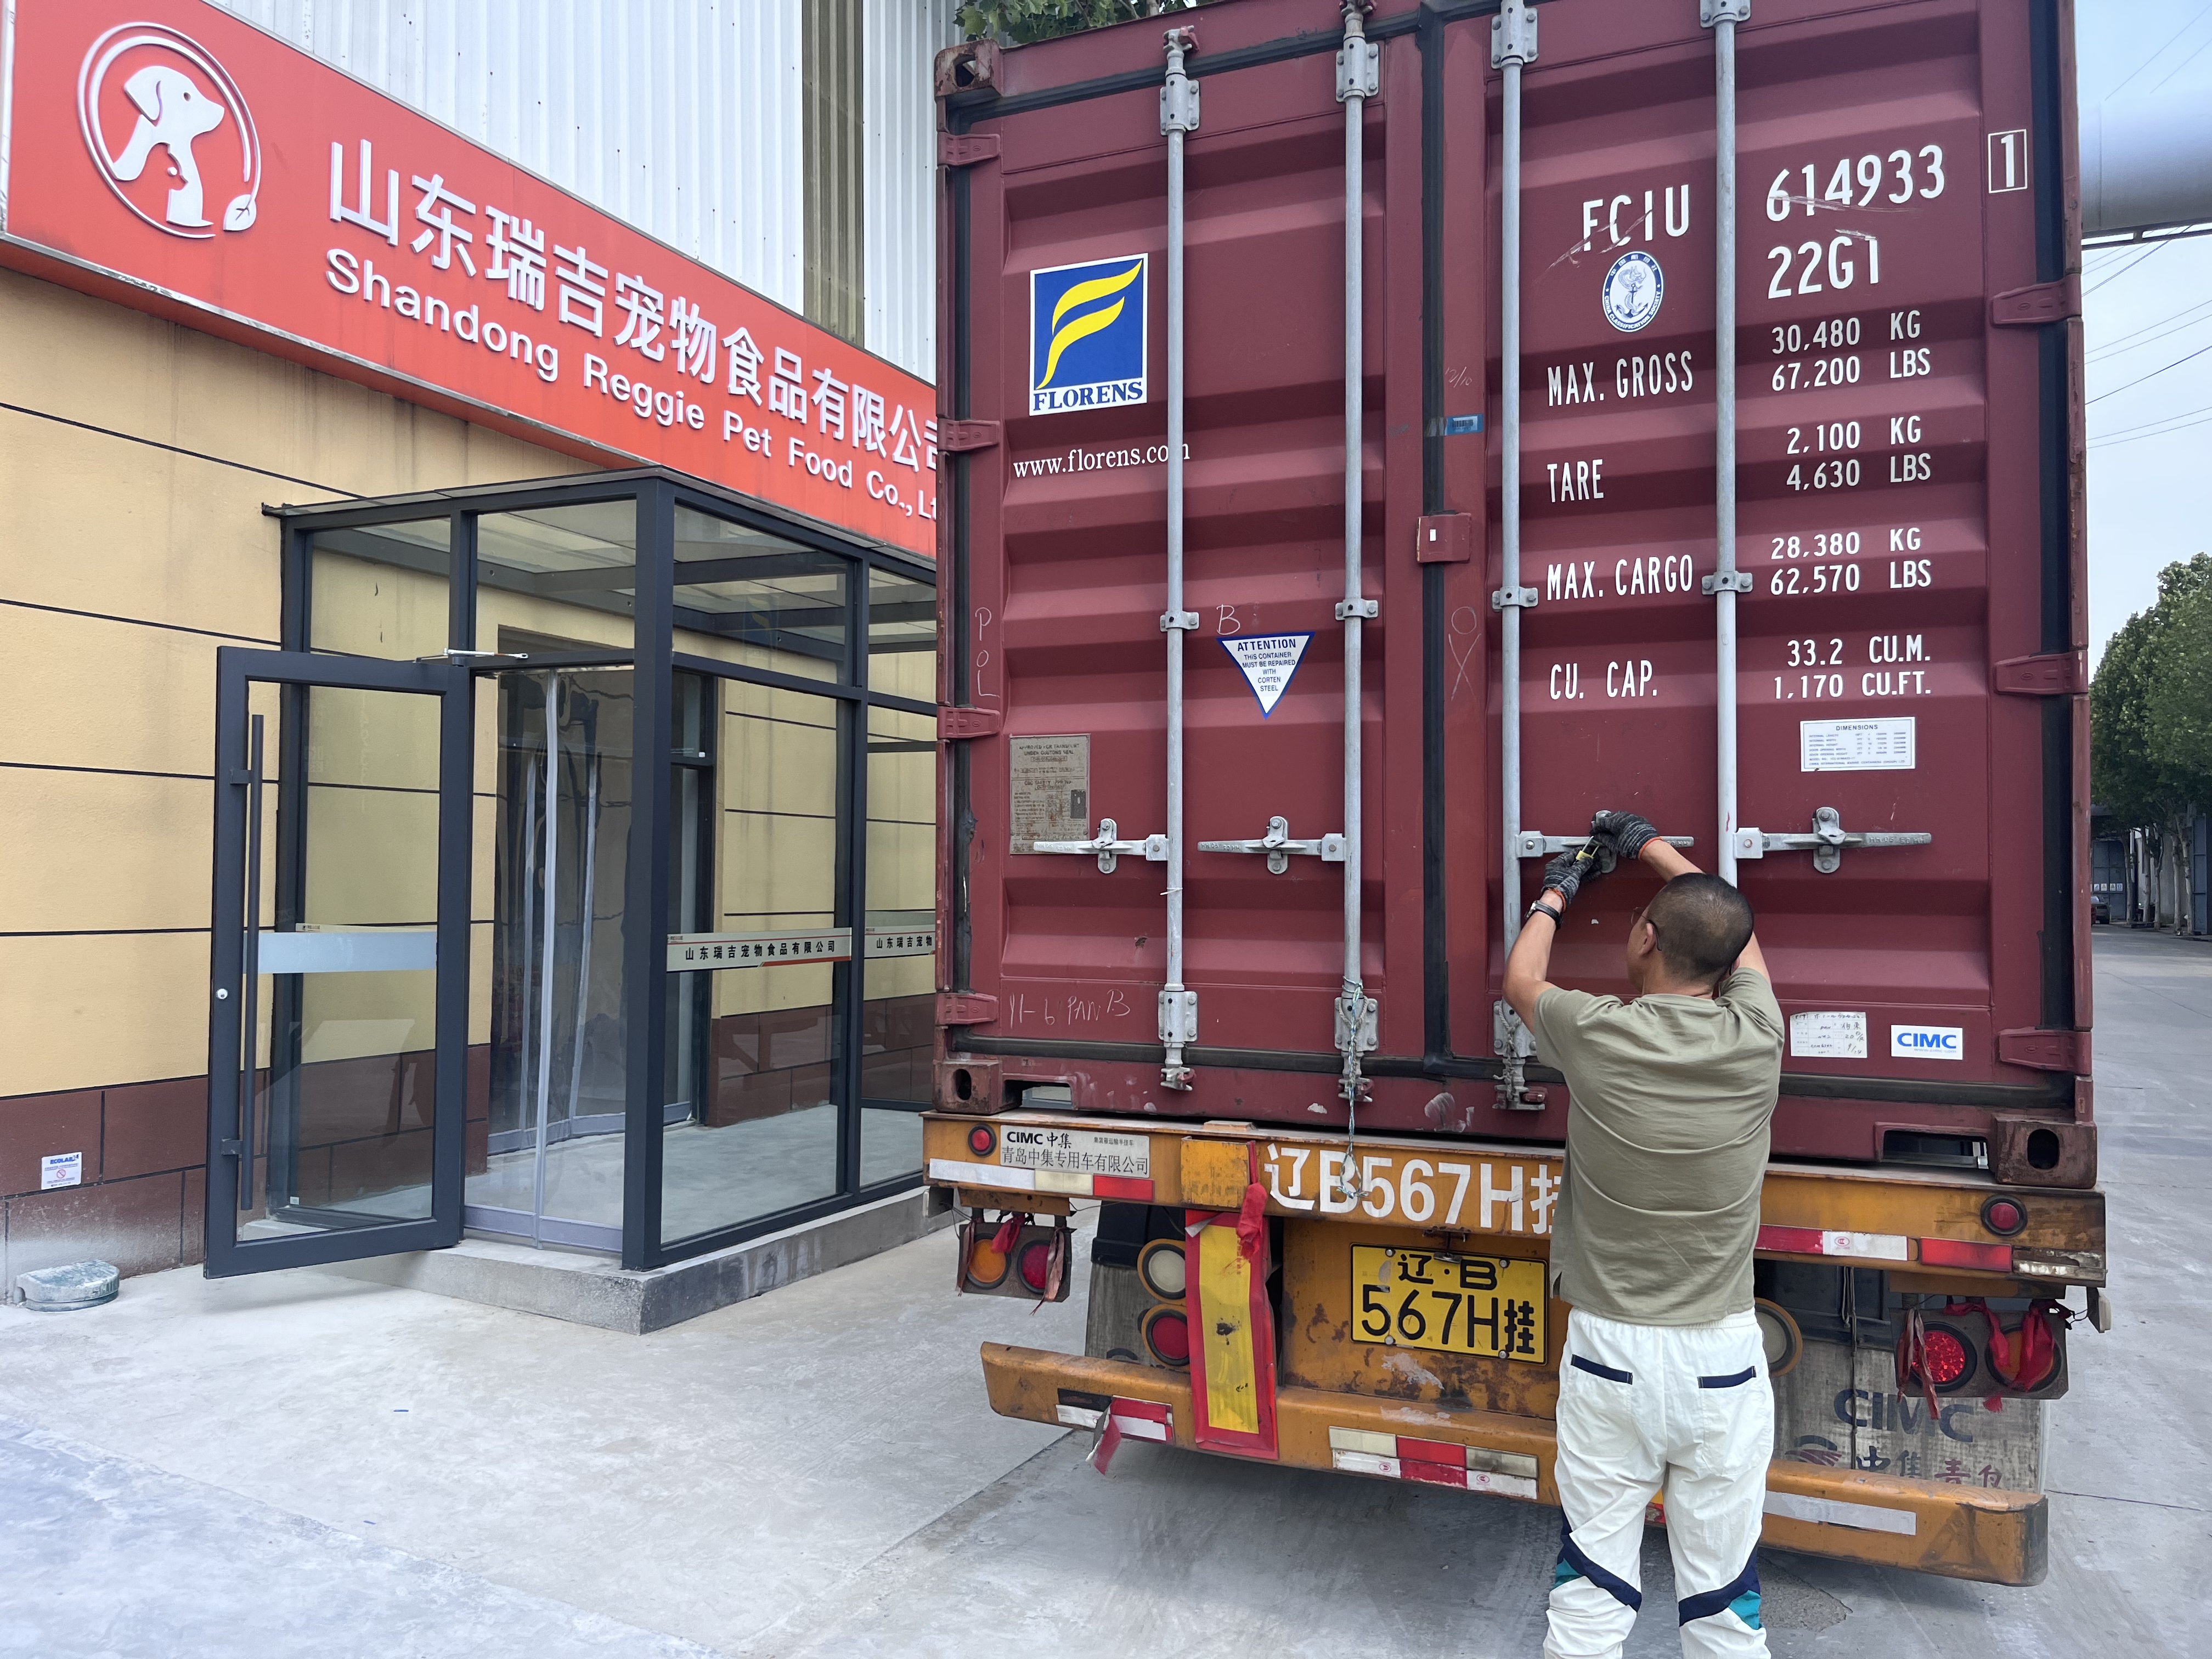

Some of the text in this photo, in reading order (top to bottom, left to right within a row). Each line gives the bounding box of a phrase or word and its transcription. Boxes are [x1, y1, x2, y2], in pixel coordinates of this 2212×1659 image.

[1766, 134, 2015, 222] 614933 1
[1583, 184, 1689, 251] FCIU
[1767, 235, 1879, 299] 22G1
[1609, 313, 1651, 329] CLASSIFICATION
[1649, 291, 1661, 315] SOCIETY
[1771, 310, 1920, 354] 30,480 KG
[326, 249, 558, 382] Shandong
[584, 352, 704, 430] Reggie
[724, 410, 771, 458] Pet
[788, 437, 852, 489] Food
[866, 471, 912, 517] Co.,
[1548, 351, 1692, 406] MAX. GROSS
[1771, 348, 1931, 391] 67,200 LBS
[1033, 381, 1143, 411] FLORENS
[1787, 415, 1921, 454] 2,100 KG
[1547, 459, 1604, 503] TARE
[1786, 453, 1931, 490] 4,630 LBS
[1771, 527, 1921, 560] 28,380 KG
[1547, 554, 1692, 600] MAX. CARGO
[1770, 559, 1931, 595] 62,570 LBS
[1216, 604, 1240, 635] B
[1238, 639, 1296, 652] ATTENTION
[1787, 634, 1931, 667] 33.2 CU.M.
[1550, 660, 1657, 699] CU. CAP.
[1774, 671, 1932, 699] 1,170 CU.FT.
[685, 940, 835, 961] 山东瑞吉宠物食品有限公司
[1897, 1032, 1956, 1049] CIMC
[1007, 1131, 1072, 1149] CIMC 中集
[1002, 1146, 1148, 1175] 青岛中集专用车有限公司
[1362, 1284, 1535, 1355] 567H挂
[1834, 1388, 1974, 1443] CIMC
